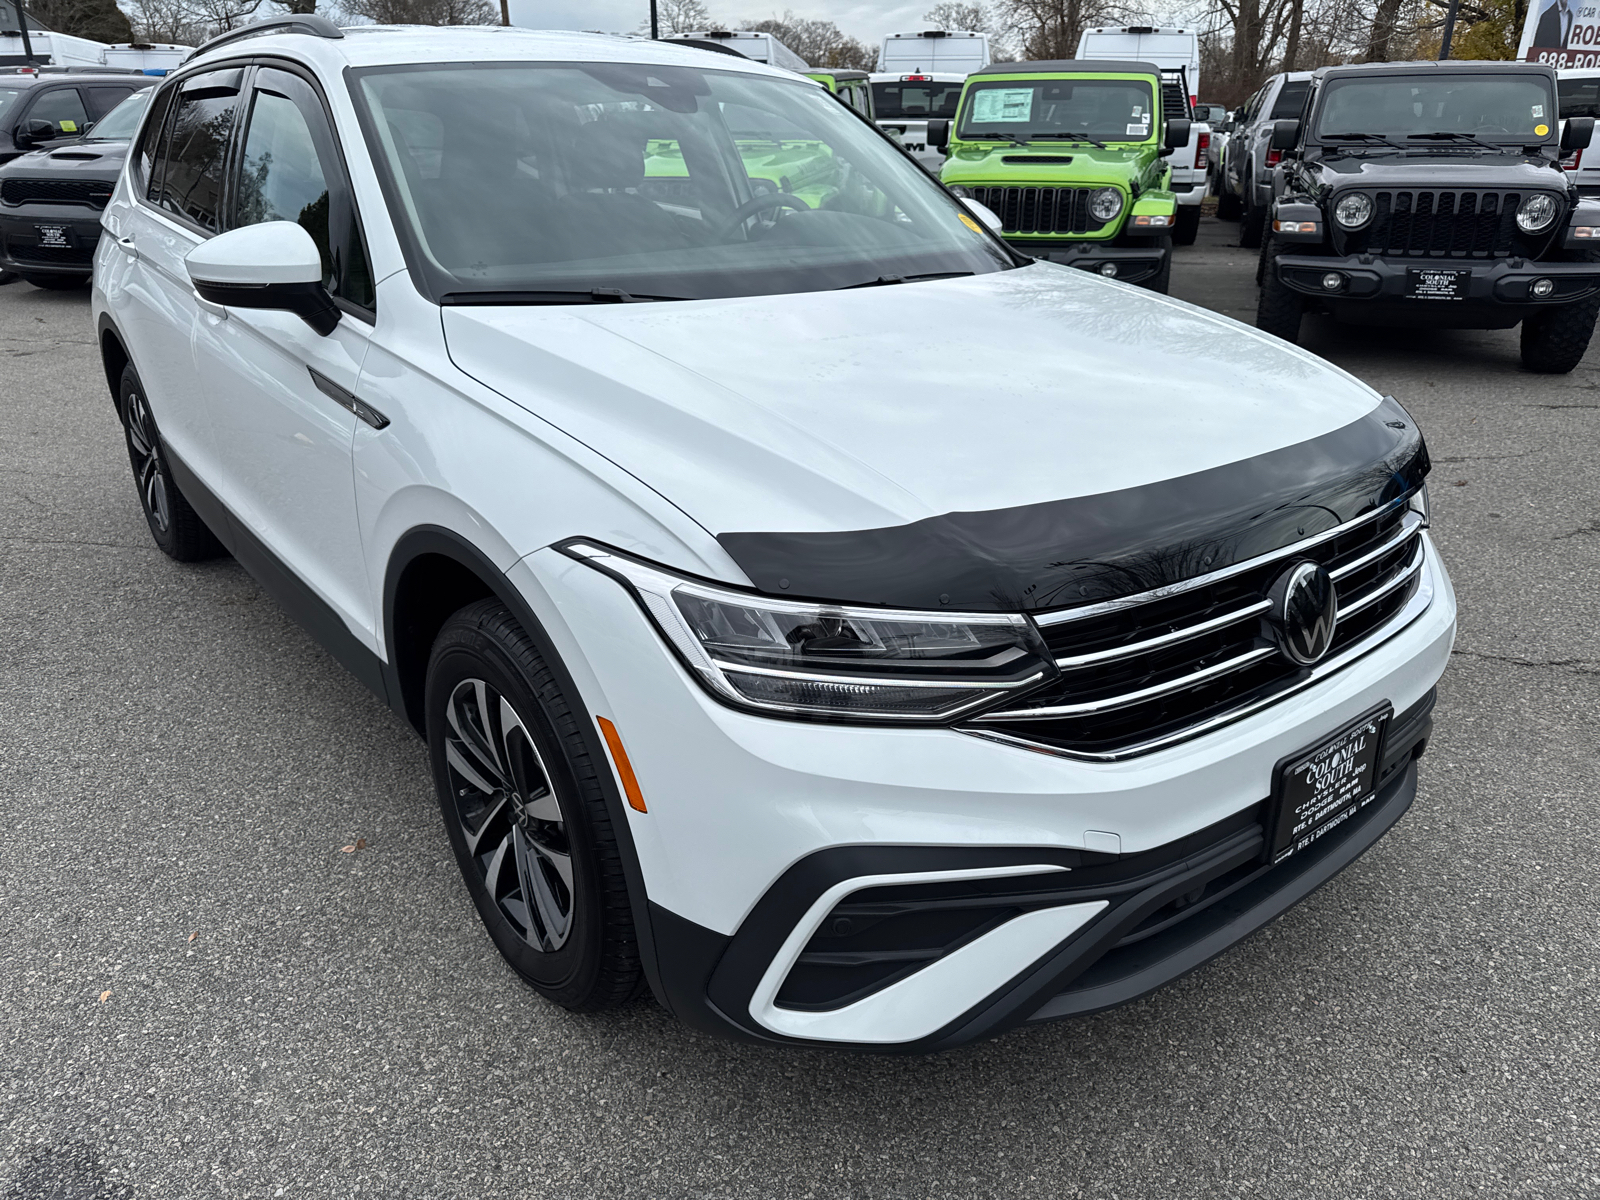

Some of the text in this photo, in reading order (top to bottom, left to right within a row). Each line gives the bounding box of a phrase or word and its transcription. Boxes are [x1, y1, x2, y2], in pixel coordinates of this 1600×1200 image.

[1306, 735, 1367, 784] COLONIAL
[1314, 737, 1348, 763] COLONIAL
[1294, 762, 1367, 814] CHRYSLER Jeep
[1314, 755, 1355, 795] SOUTH
[1300, 777, 1359, 820] DODGE RAM
[1308, 817, 1313, 825] 6
[1352, 785, 1362, 796] MA
[1349, 805, 1357, 816] MA
